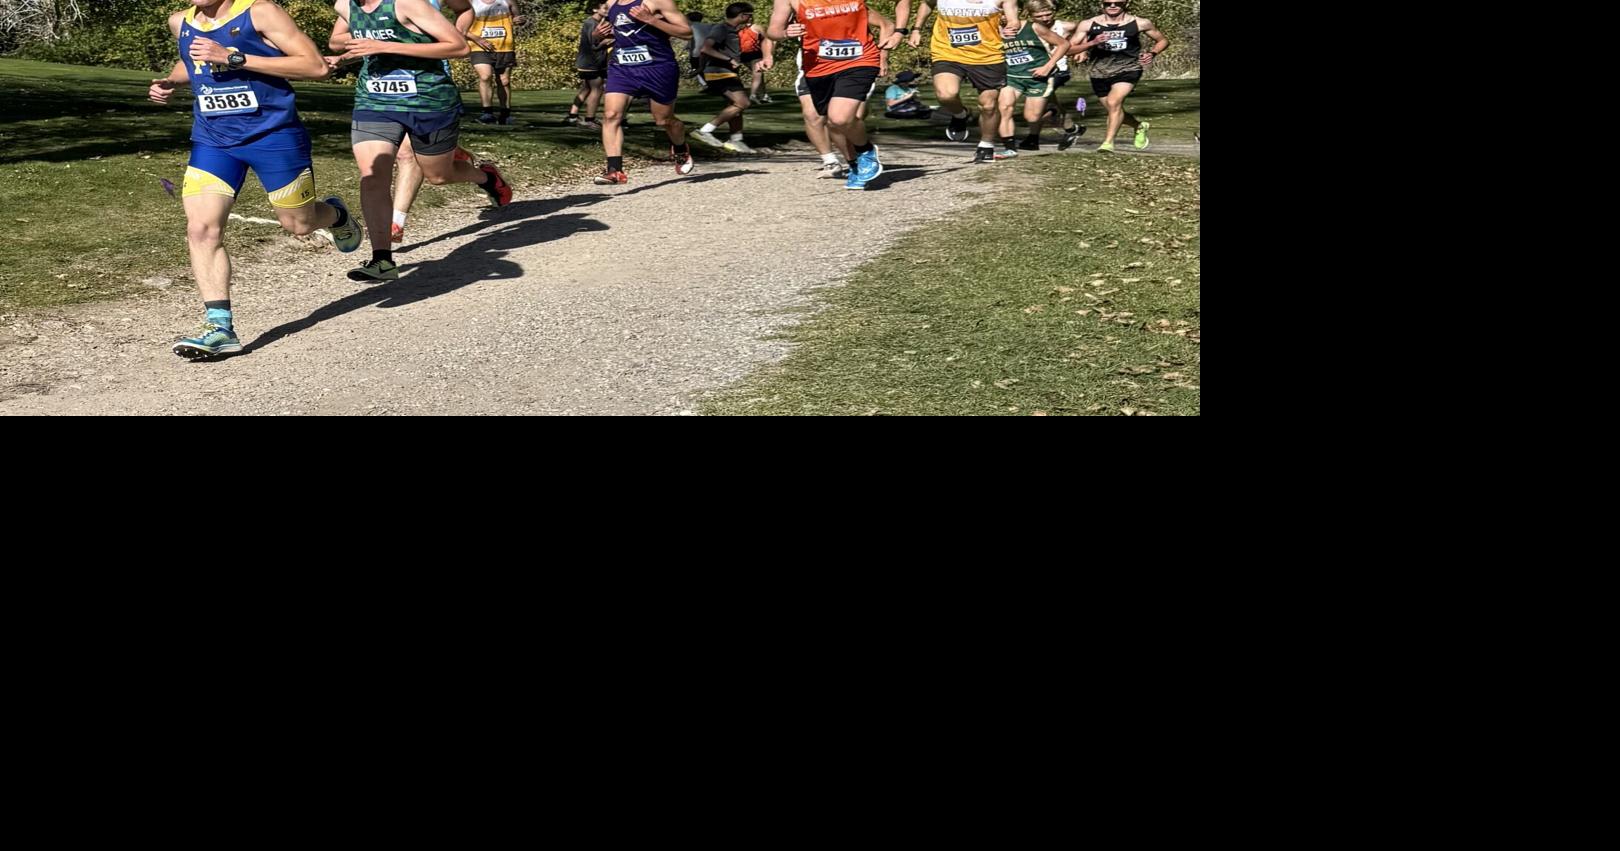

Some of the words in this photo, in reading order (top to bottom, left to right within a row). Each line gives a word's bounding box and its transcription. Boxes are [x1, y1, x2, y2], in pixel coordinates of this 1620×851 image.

[353, 28, 398, 40] GLACIER
[622, 53, 647, 62] 4120
[825, 47, 856, 56] 3141
[371, 81, 409, 93] 3745
[204, 93, 251, 110] 3583
